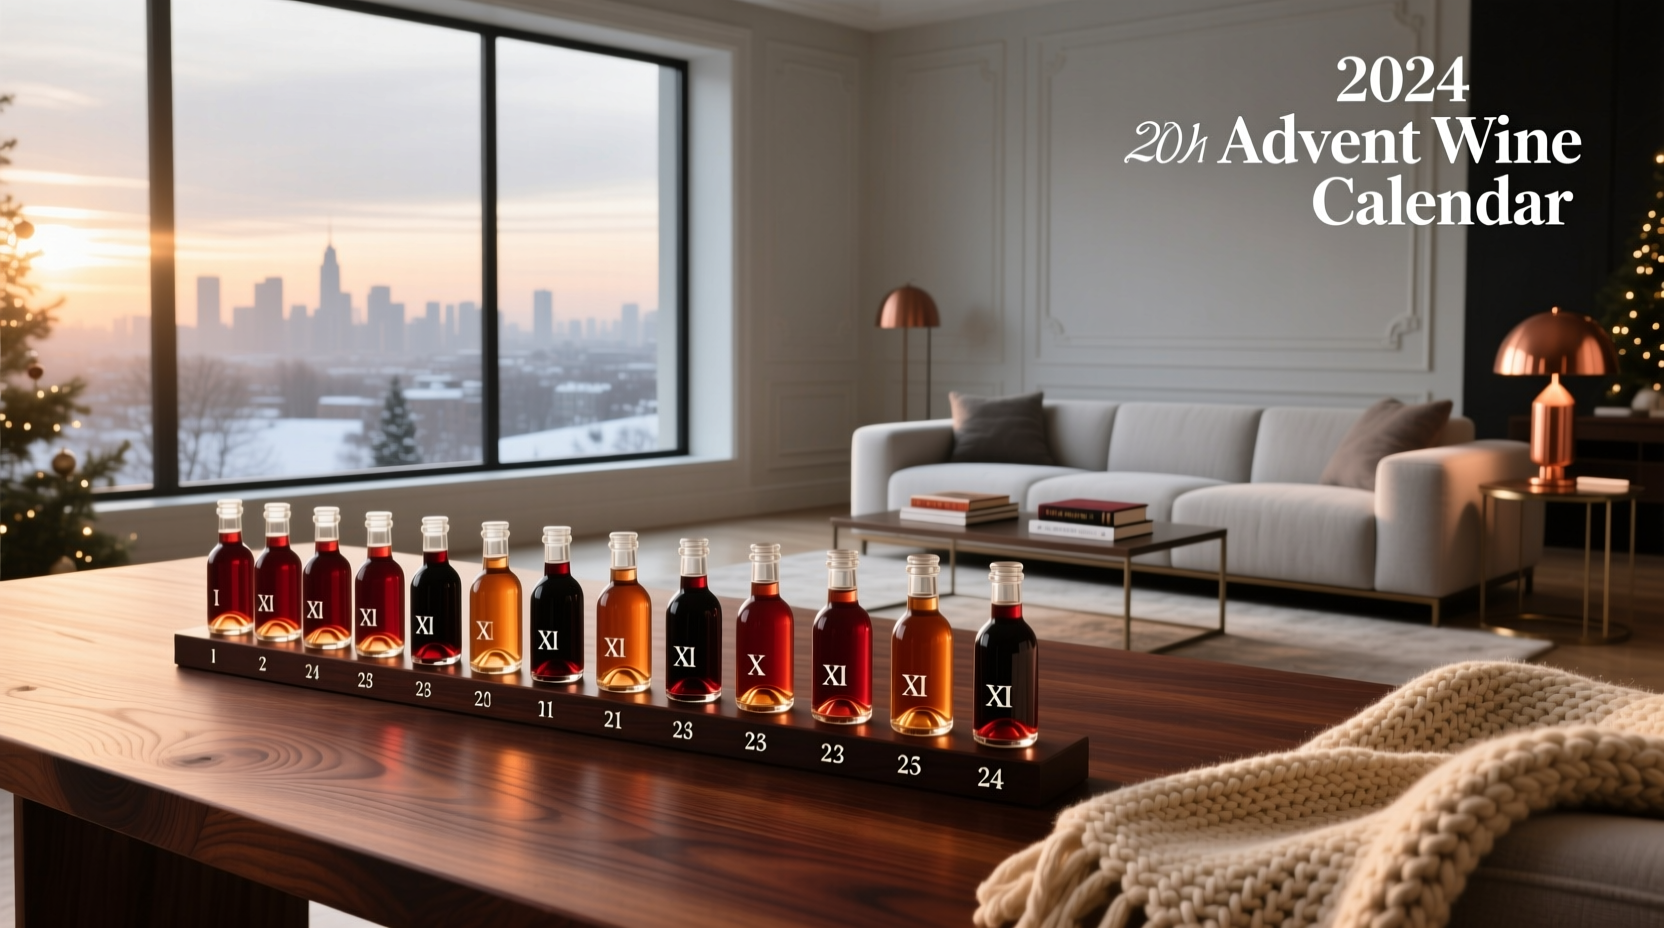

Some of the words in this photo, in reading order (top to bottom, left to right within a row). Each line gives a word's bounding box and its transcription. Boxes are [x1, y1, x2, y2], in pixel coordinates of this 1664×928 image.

[258, 594, 274, 612] XI
[307, 600, 324, 619] XI
[360, 608, 377, 627] XI
[415, 615, 434, 635] XI
[538, 630, 558, 650] XI
[604, 637, 626, 658] XI
[211, 649, 216, 663] 1
[258, 656, 267, 672] 2
[673, 646, 696, 668] XI
[747, 654, 766, 676] X
[822, 664, 848, 687] XI
[902, 674, 928, 697] XI
[985, 684, 1013, 708] XI
[604, 711, 622, 729] 21
[745, 732, 767, 752] 23
[821, 743, 845, 764] 23
[897, 754, 921, 776] 25
[977, 766, 1004, 790] 24
